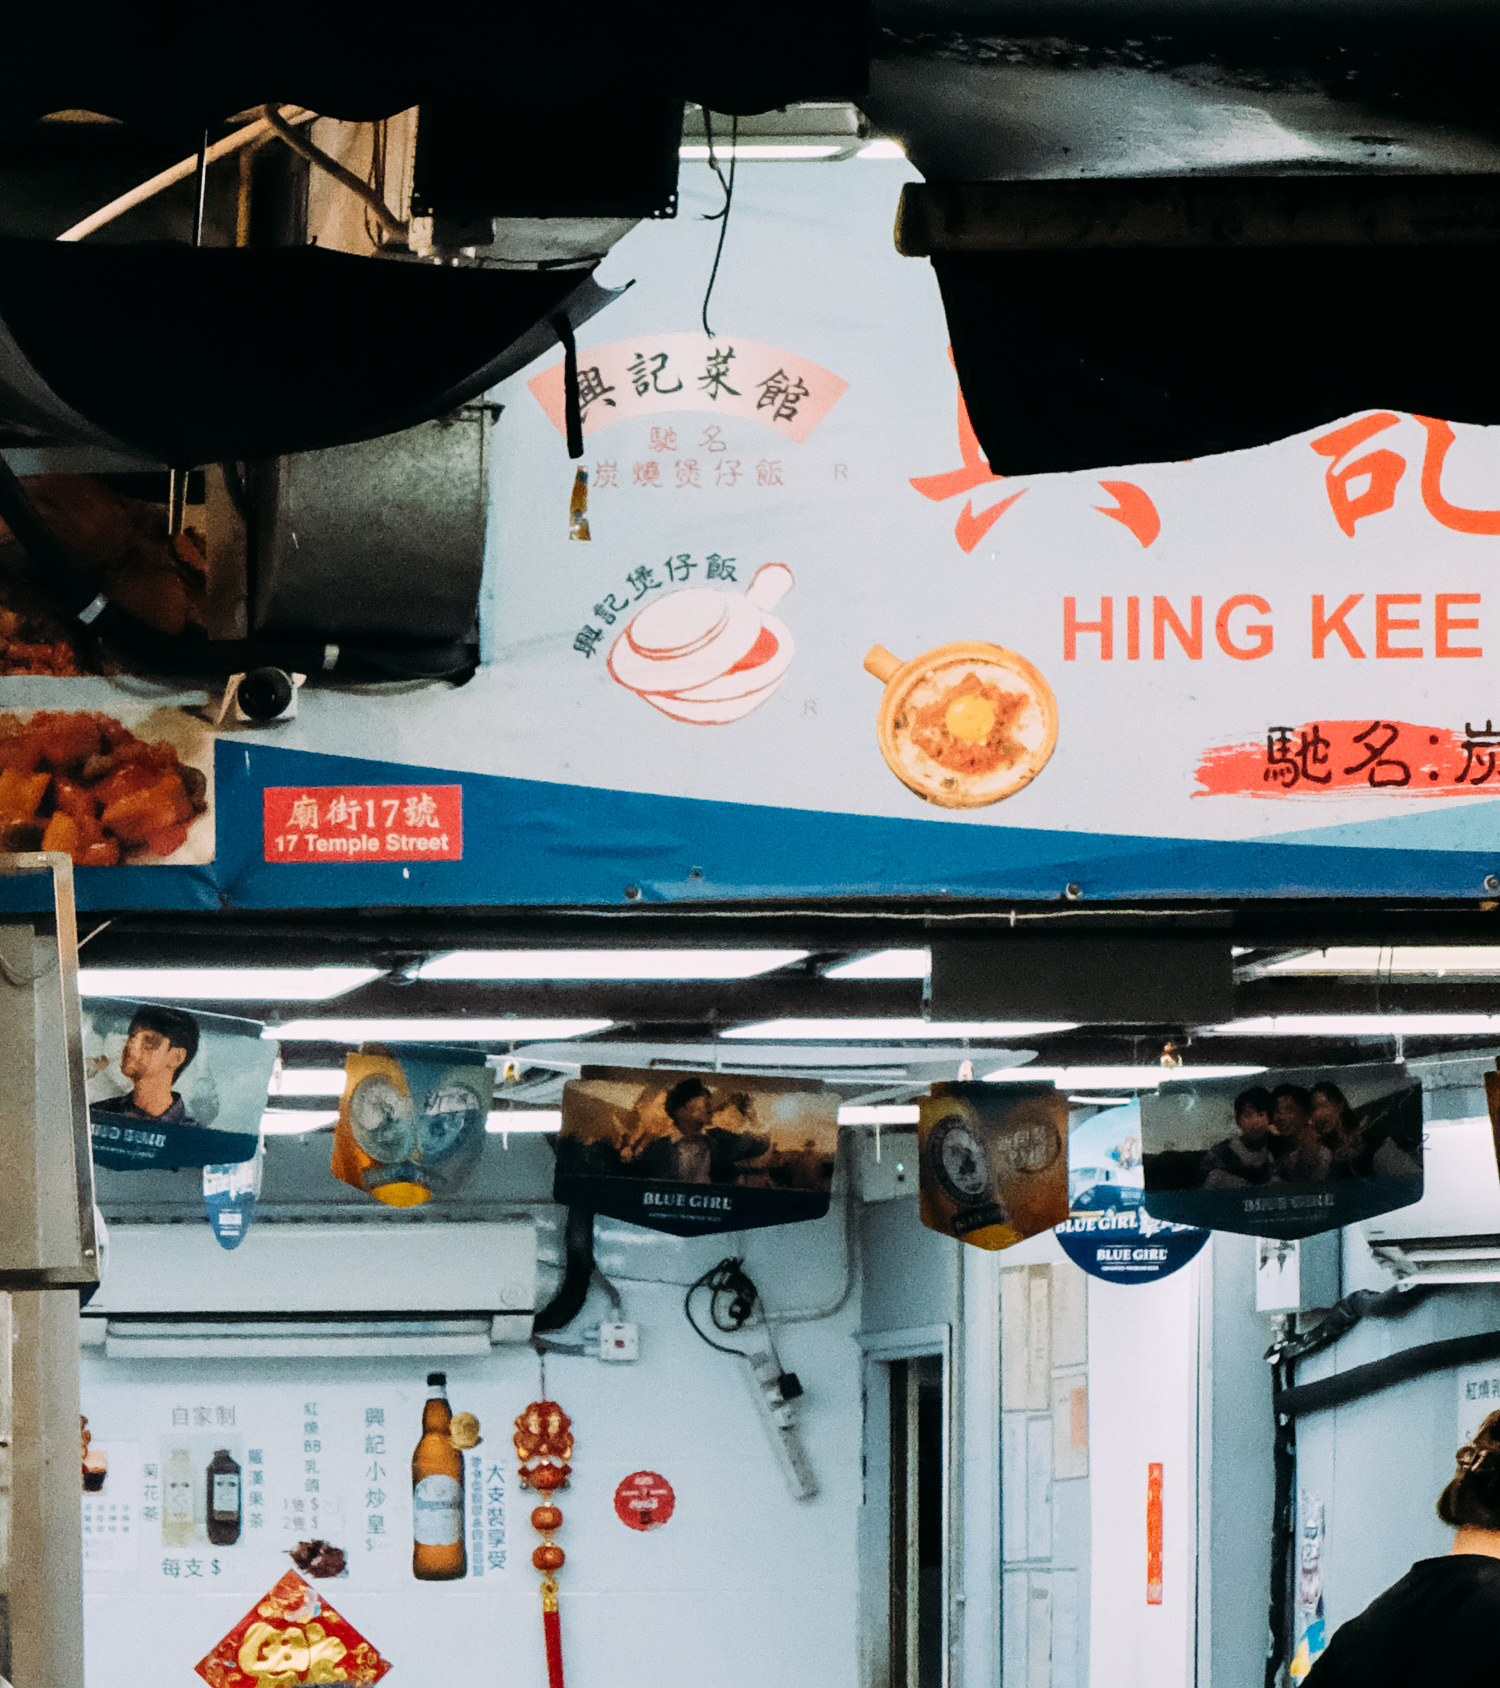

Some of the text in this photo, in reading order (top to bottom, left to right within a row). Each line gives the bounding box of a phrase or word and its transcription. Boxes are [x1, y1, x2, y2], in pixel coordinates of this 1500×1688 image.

[592, 458, 786, 489] 炭燒煲仔飯
[573, 552, 739, 659] 興記煲仔飯
[1062, 592, 1484, 662] HING KEE
[285, 792, 441, 831] 廟街17號
[275, 832, 450, 856] 17 Temple Street
[643, 1191, 733, 1211] BLUE GIRL
[1054, 1216, 1096, 1235] BLUE
[1098, 1214, 1139, 1230] GIRL
[1096, 1248, 1169, 1262] BLUE GIRL
